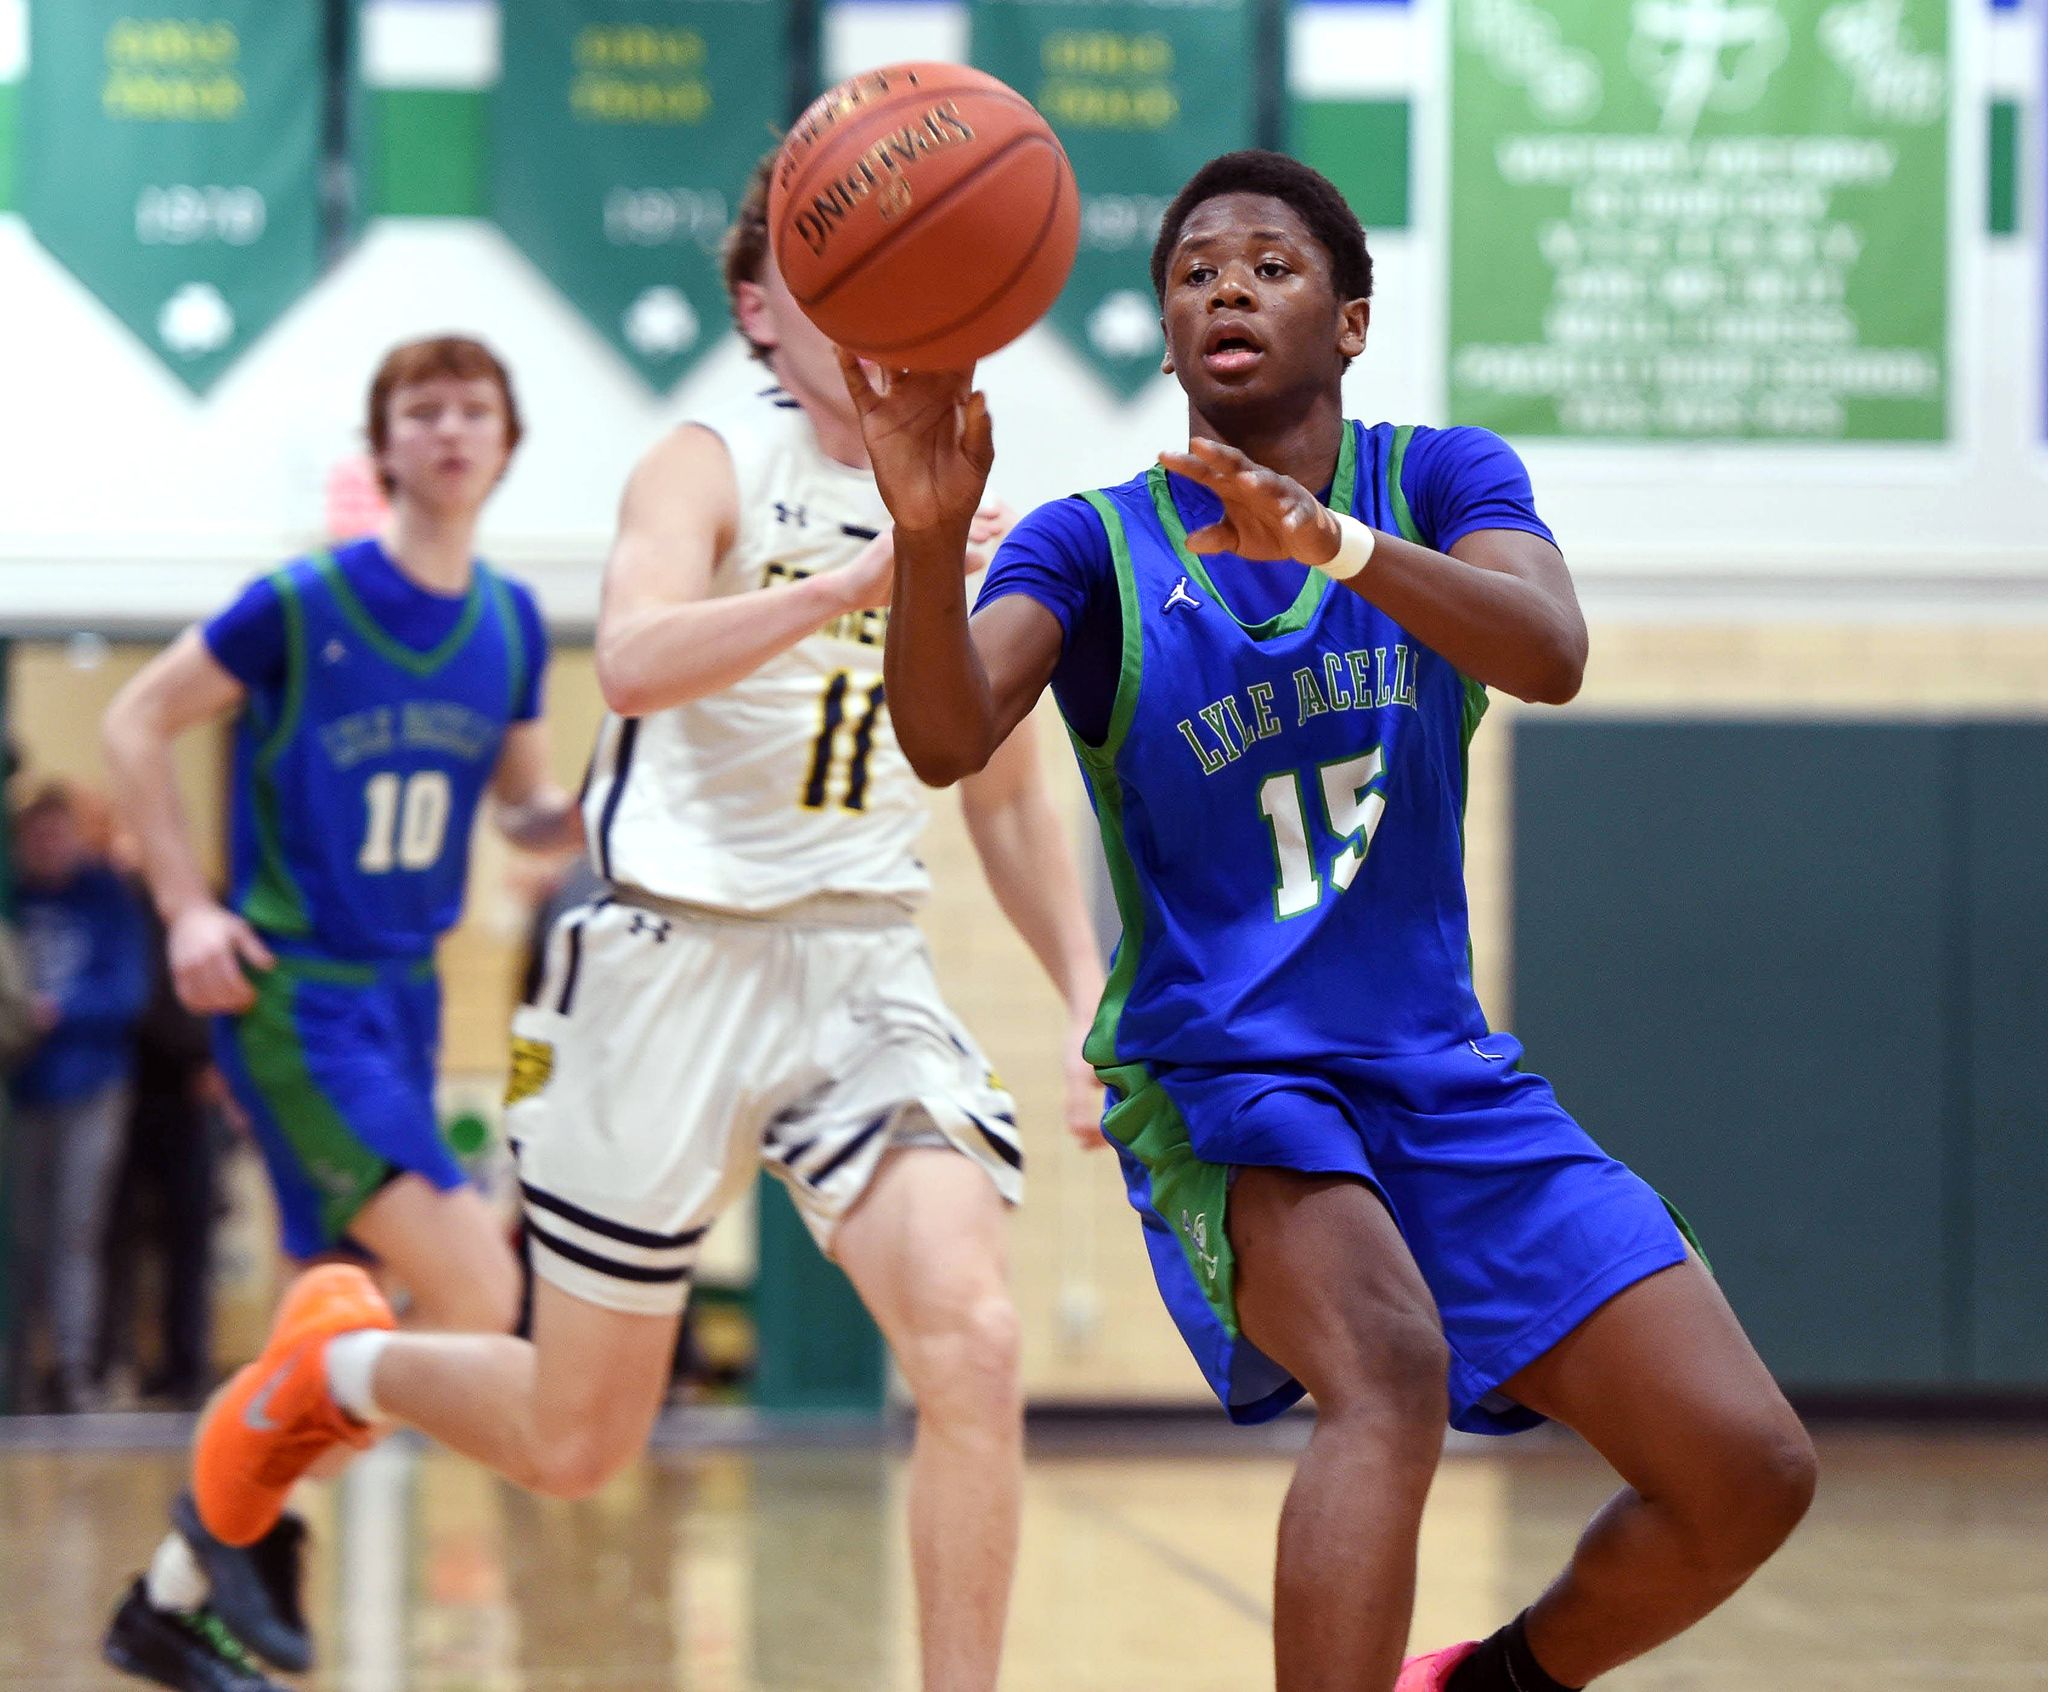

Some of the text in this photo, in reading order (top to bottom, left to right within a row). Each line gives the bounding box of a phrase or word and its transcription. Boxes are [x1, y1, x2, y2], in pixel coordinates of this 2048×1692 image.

[793, 99, 975, 257] SPALDING
[798, 666, 886, 815] 11
[1177, 643, 1419, 777] LYLE PACELL
[358, 770, 452, 874] 10
[1257, 741, 1388, 923] 15
